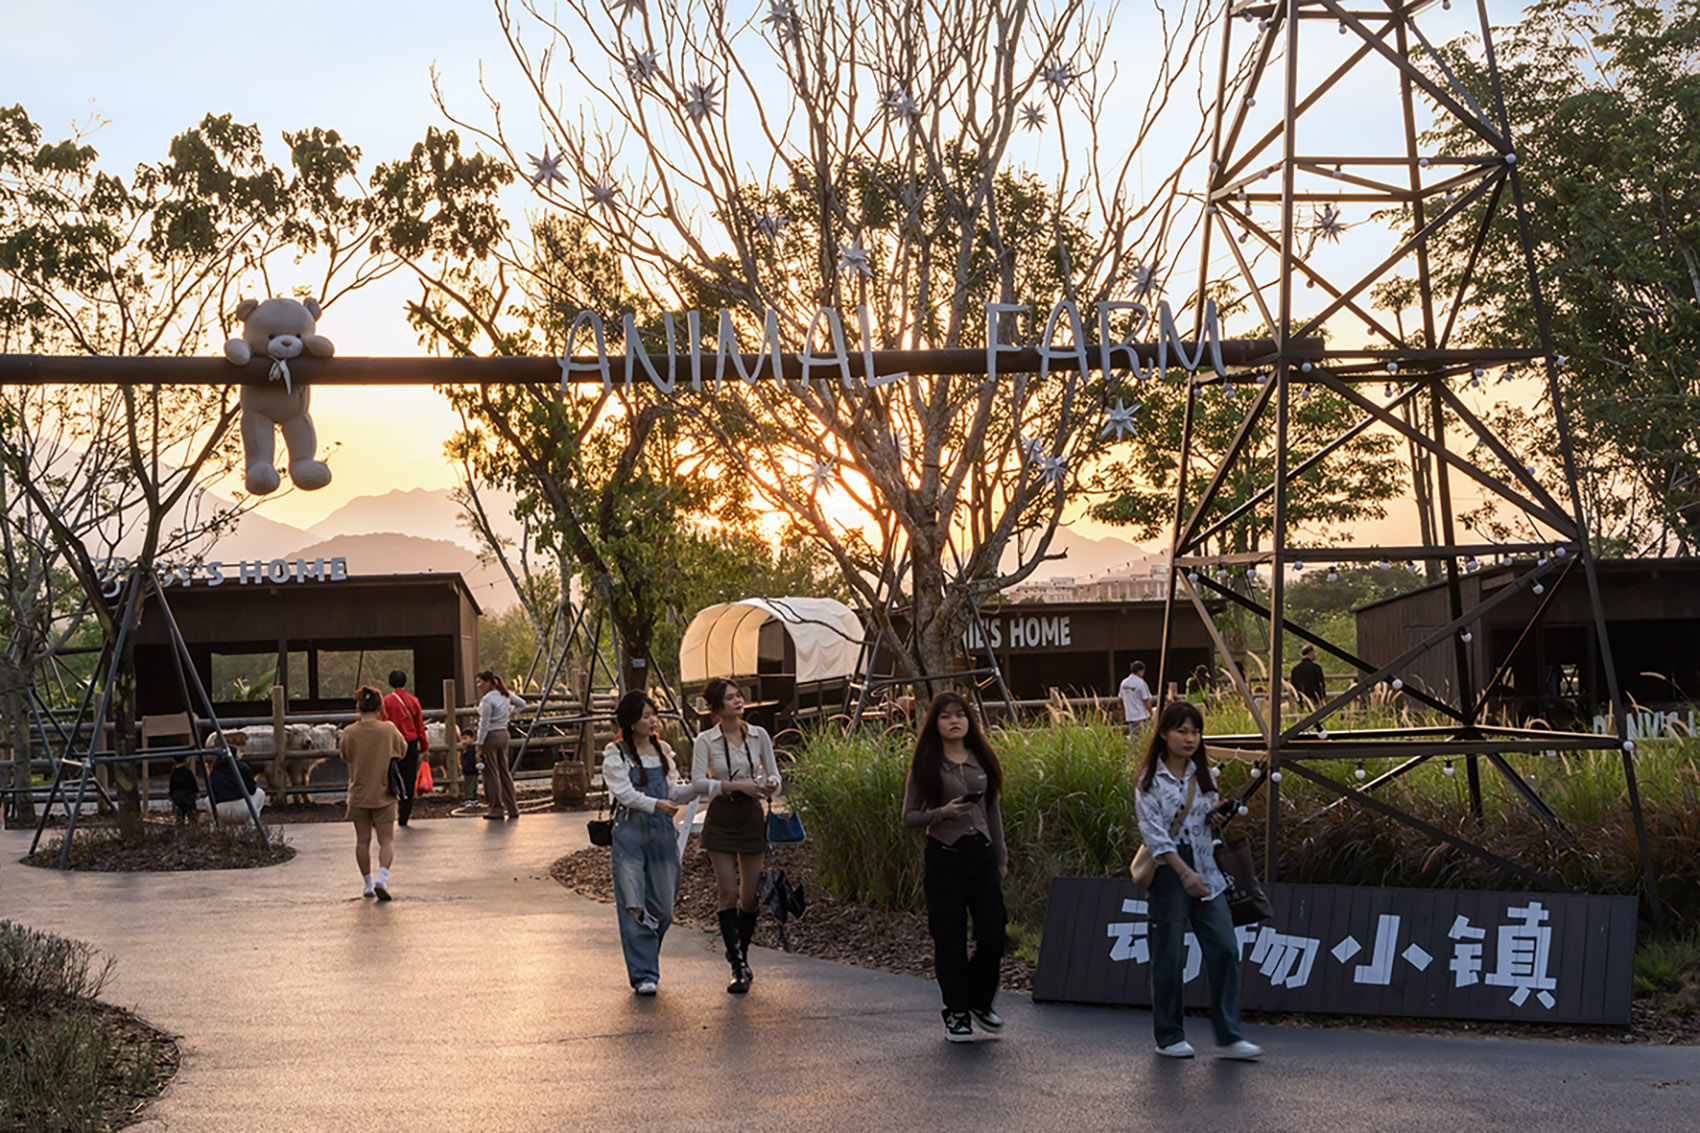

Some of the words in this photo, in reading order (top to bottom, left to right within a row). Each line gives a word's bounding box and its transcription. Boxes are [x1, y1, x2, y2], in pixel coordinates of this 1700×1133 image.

[556, 304, 910, 395] ANIMAL
[984, 299, 1227, 382] FARM
[239, 556, 348, 585] HOME
[1009, 616, 1071, 648] HOME
